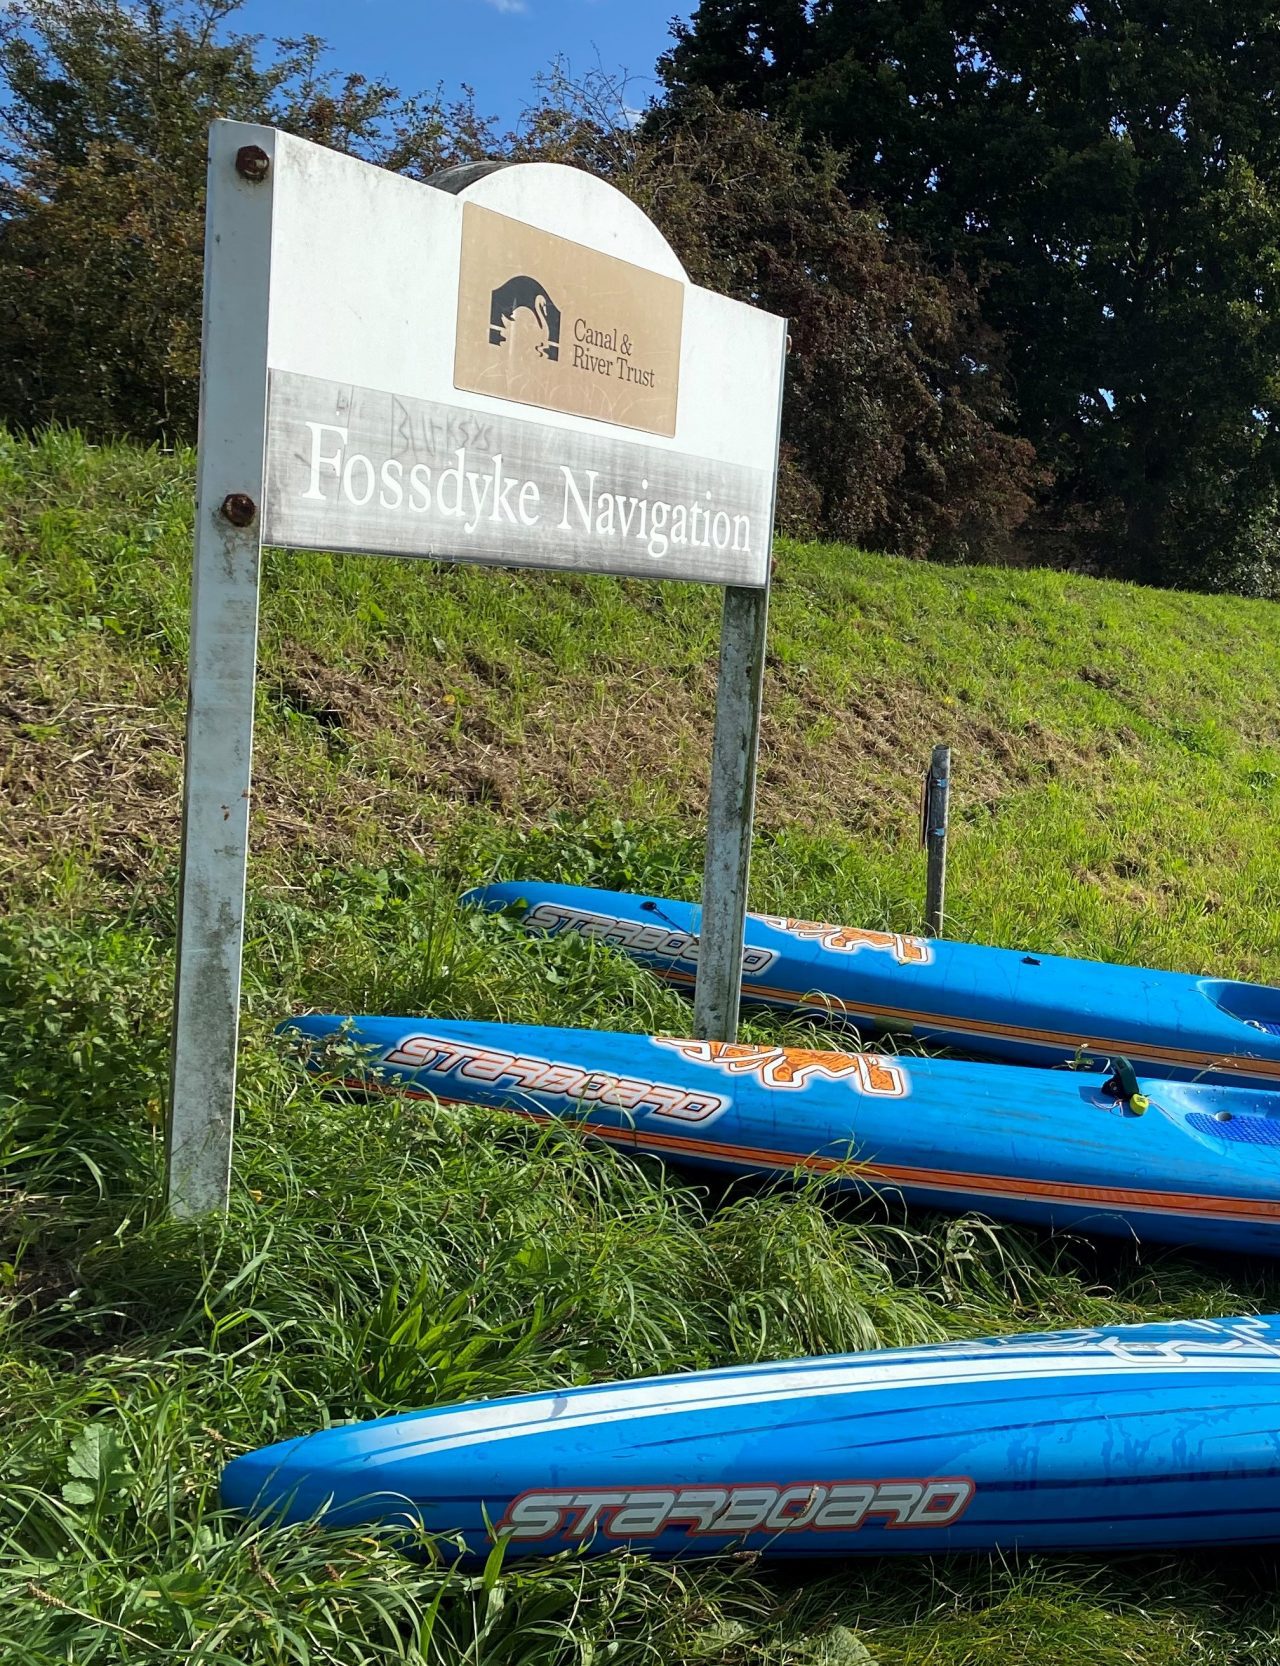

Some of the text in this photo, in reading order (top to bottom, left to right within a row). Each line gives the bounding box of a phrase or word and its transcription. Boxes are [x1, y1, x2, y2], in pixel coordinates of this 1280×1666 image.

[572, 343, 656, 388] River Trust
[573, 317, 633, 357] Canal &
[301, 420, 752, 558] Fossdyke Navigation
[523, 904, 773, 973] STARBOD
[384, 1036, 722, 1122] STARBOARD
[494, 1479, 976, 1540] STARBOARD
